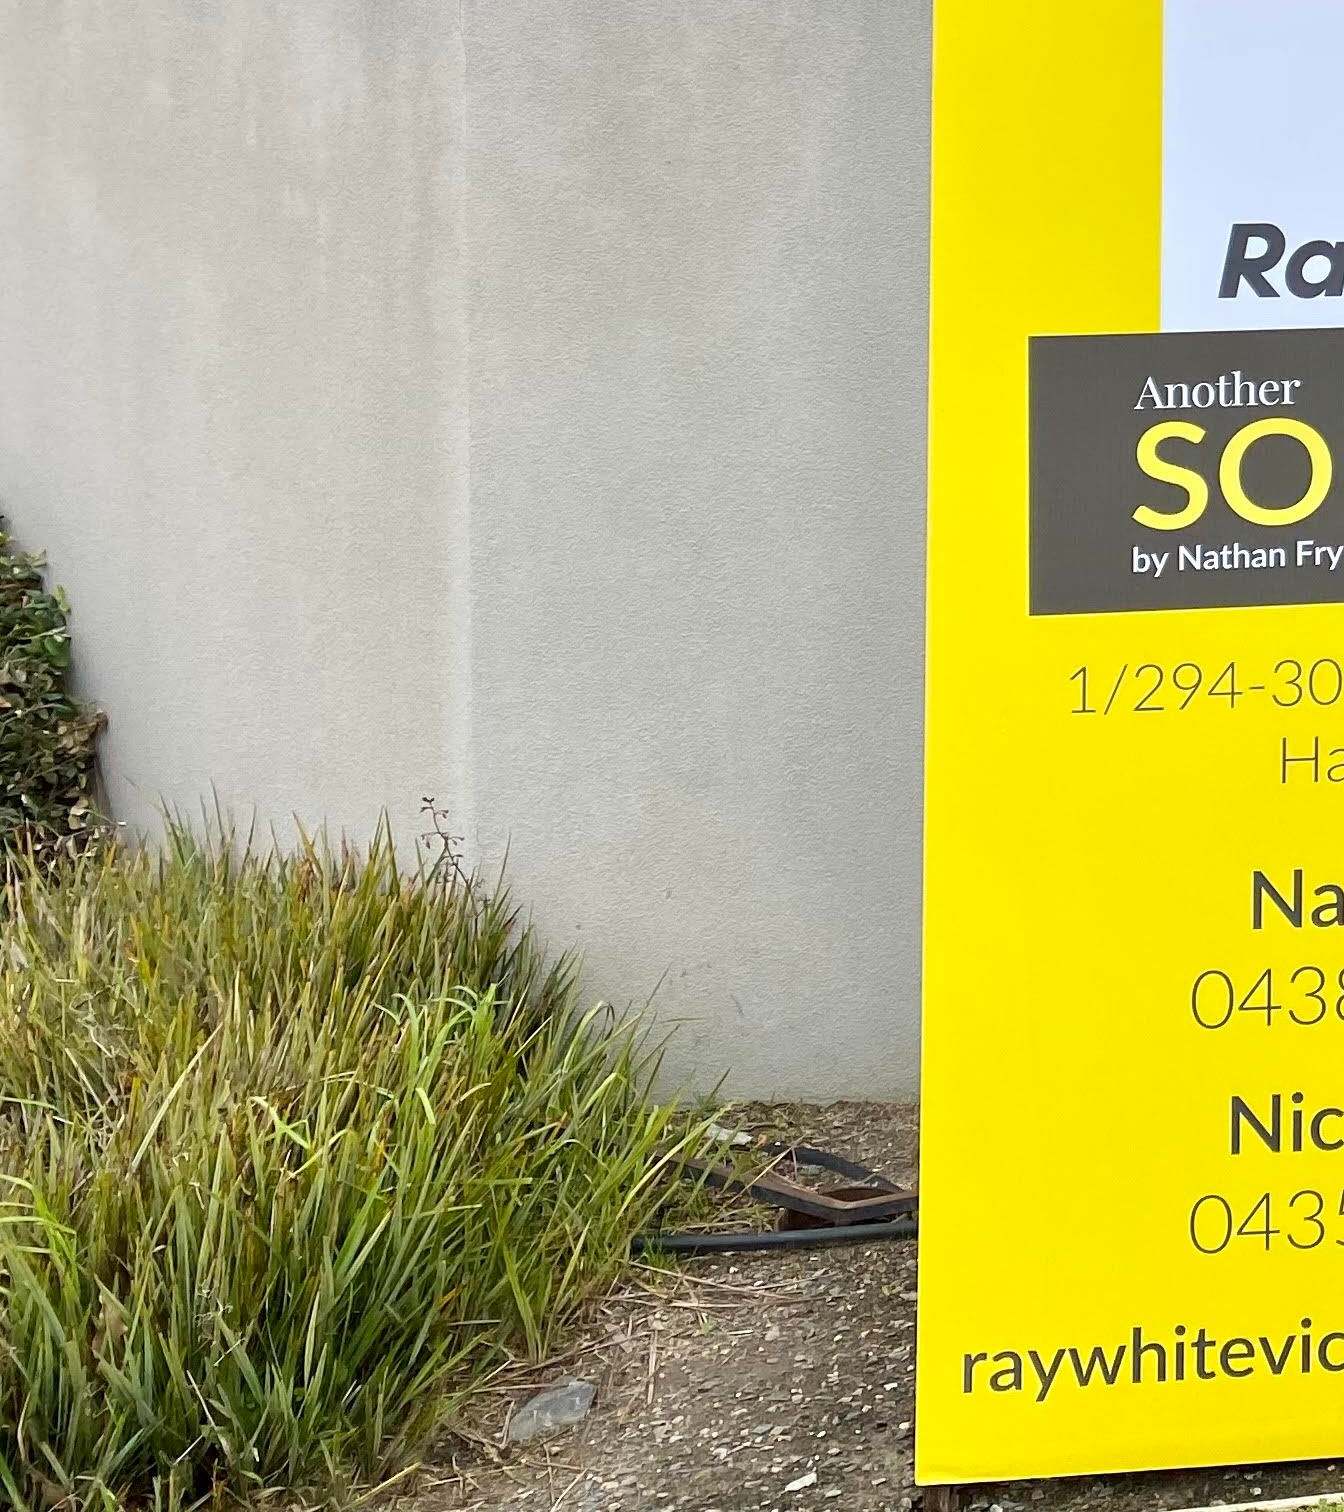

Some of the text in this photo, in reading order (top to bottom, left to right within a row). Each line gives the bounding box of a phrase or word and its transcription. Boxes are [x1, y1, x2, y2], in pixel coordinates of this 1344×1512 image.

[1133, 370, 1301, 410] Another
[1131, 539, 1344, 578] by Nathan Fry
